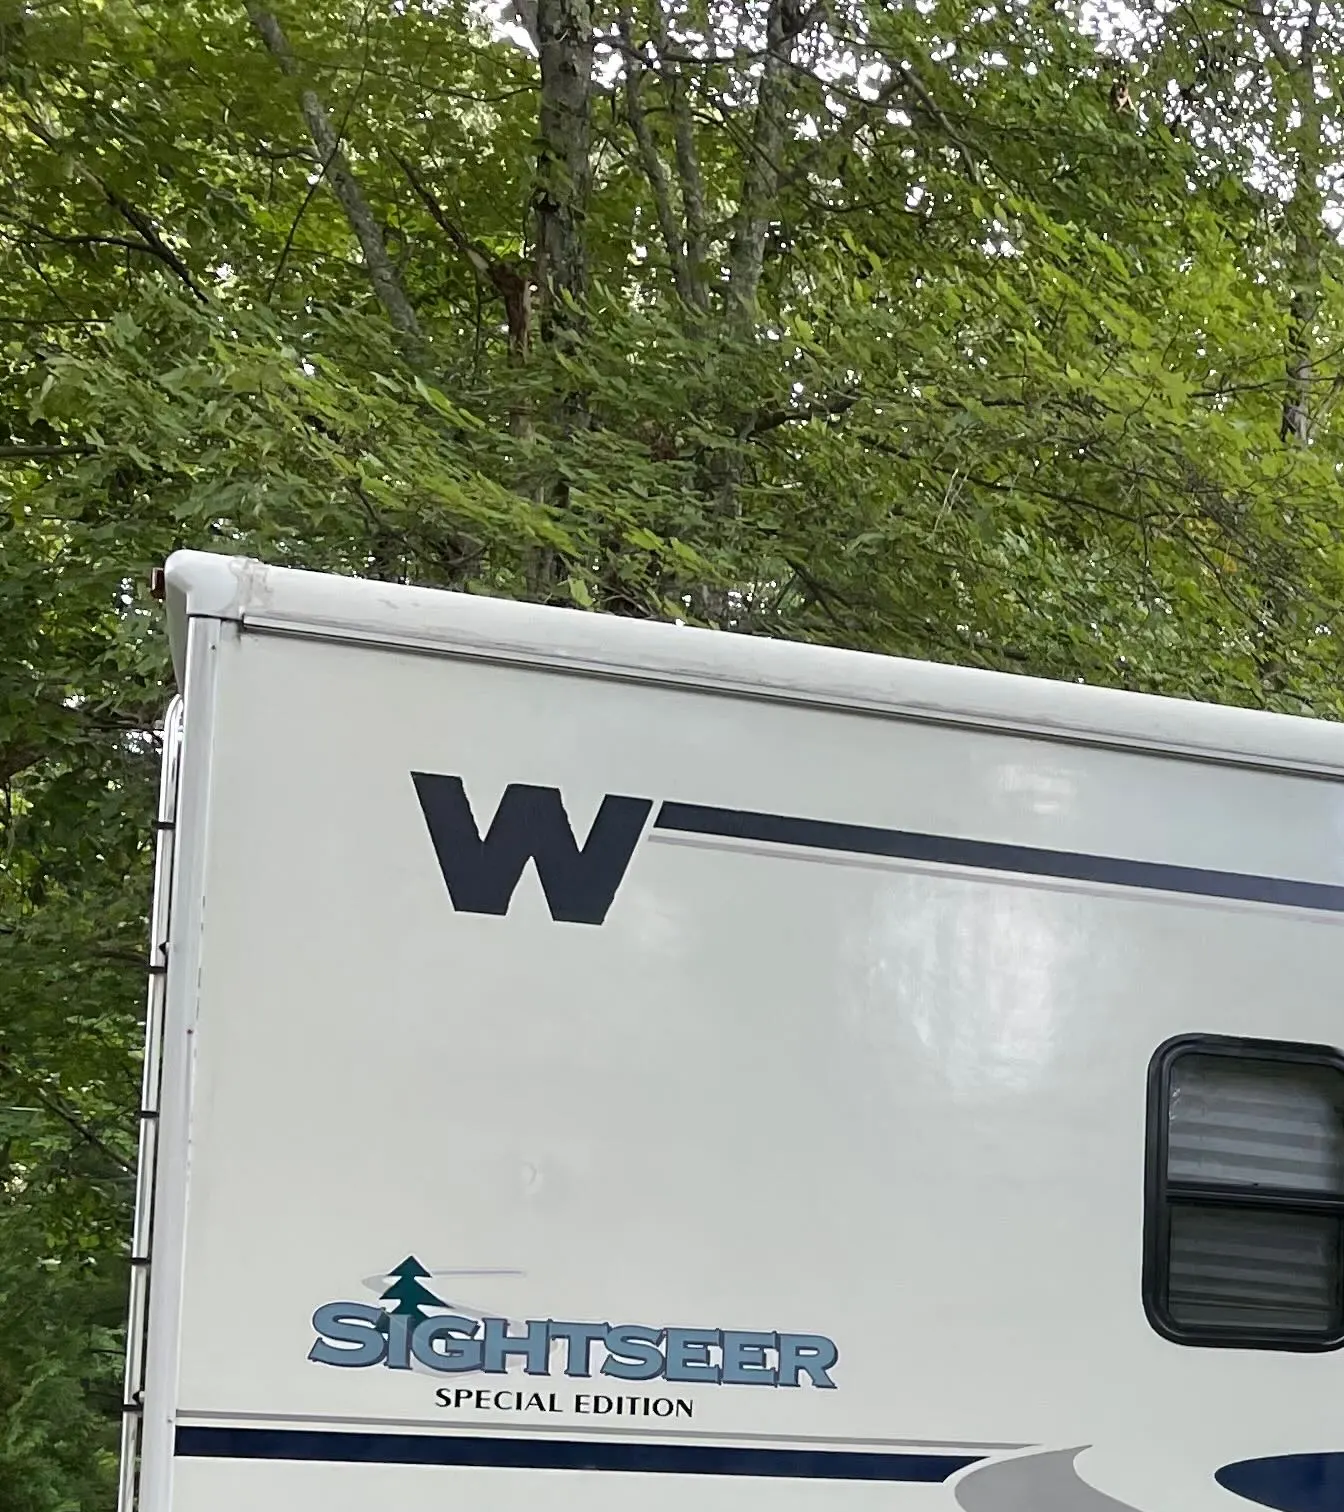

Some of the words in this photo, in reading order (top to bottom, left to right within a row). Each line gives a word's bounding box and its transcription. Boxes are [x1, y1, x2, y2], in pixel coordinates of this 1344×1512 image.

[410, 771, 653, 925] W
[308, 1301, 838, 1389] SIGHTSEER
[435, 1387, 563, 1413] SPECIAL
[575, 1394, 694, 1418] EDITION
